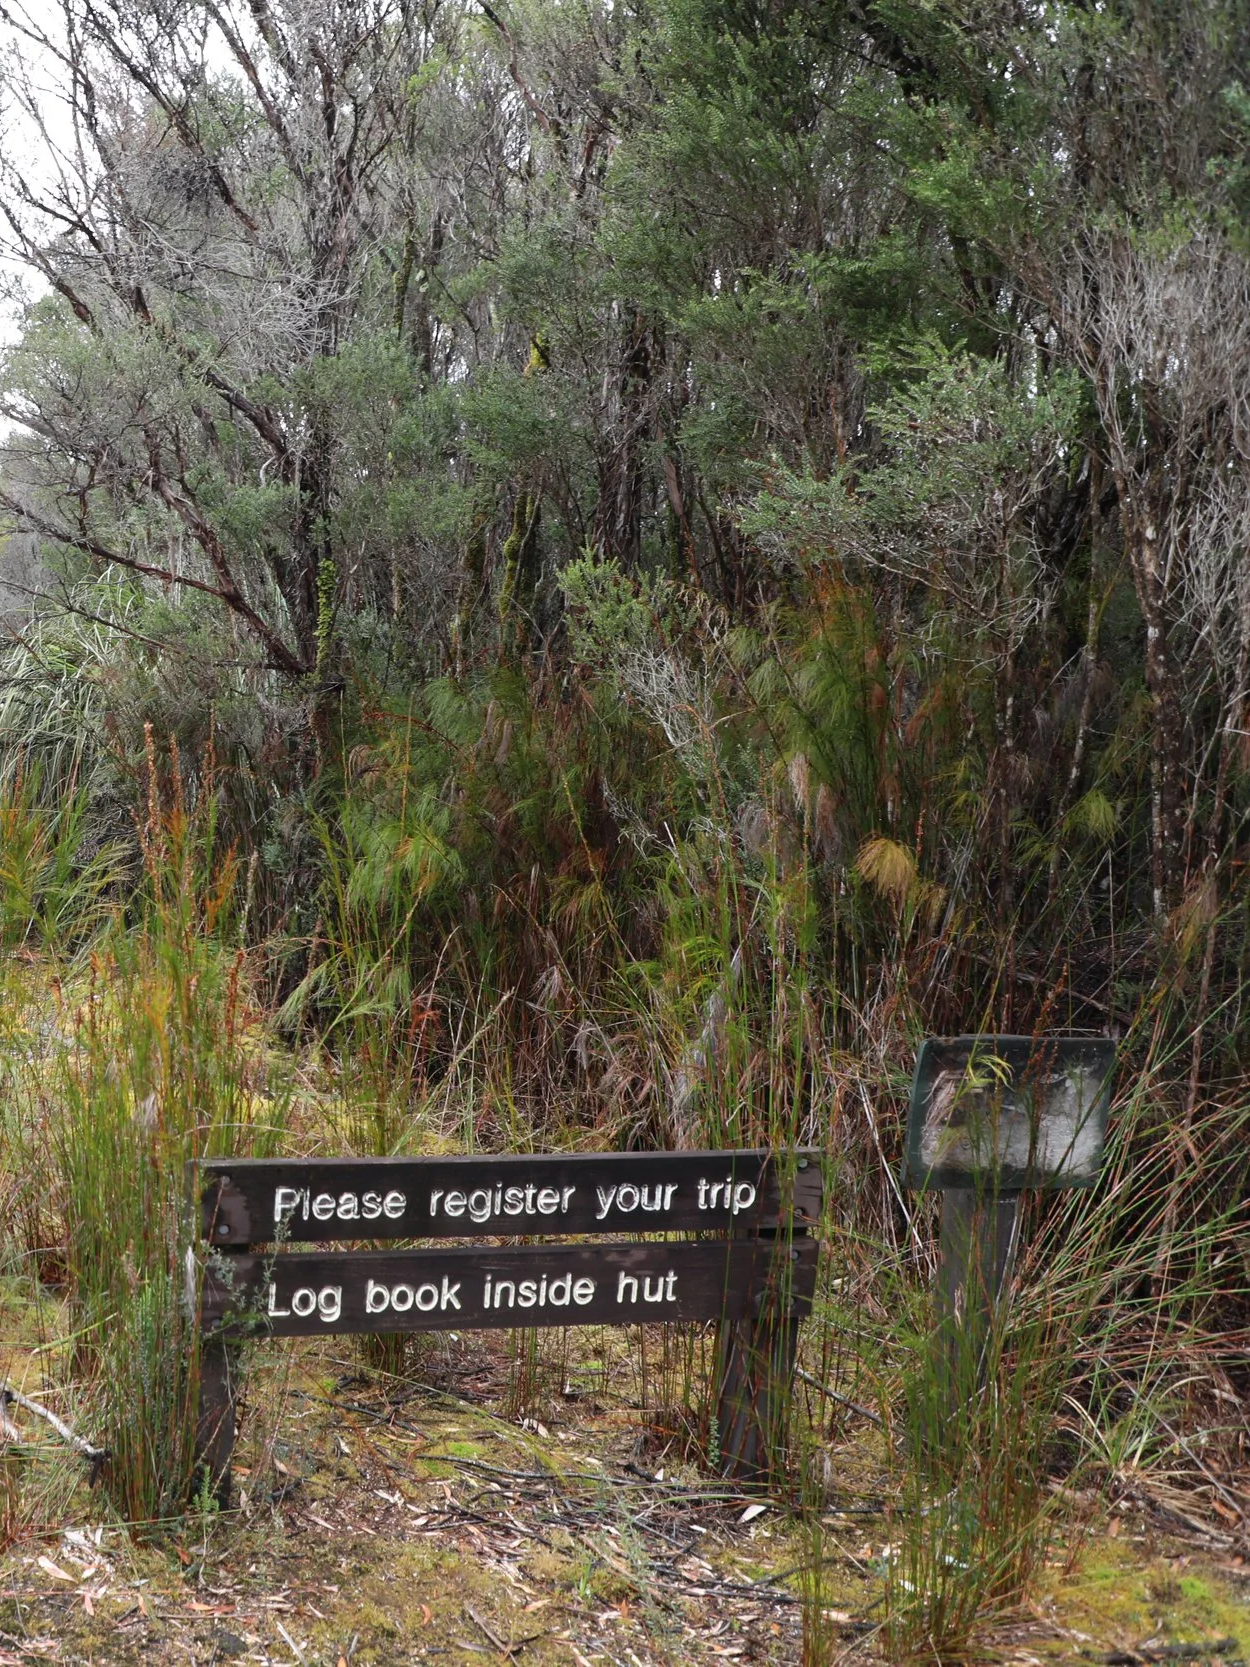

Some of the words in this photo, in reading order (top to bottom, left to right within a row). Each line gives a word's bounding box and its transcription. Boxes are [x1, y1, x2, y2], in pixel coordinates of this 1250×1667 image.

[273, 1185, 408, 1223] Please
[429, 1181, 576, 1223] register
[596, 1181, 679, 1220] your
[697, 1174, 757, 1216] trip
[267, 1281, 343, 1323] Log
[365, 1274, 462, 1314] book
[482, 1272, 596, 1310] inside
[616, 1268, 679, 1304] hut
